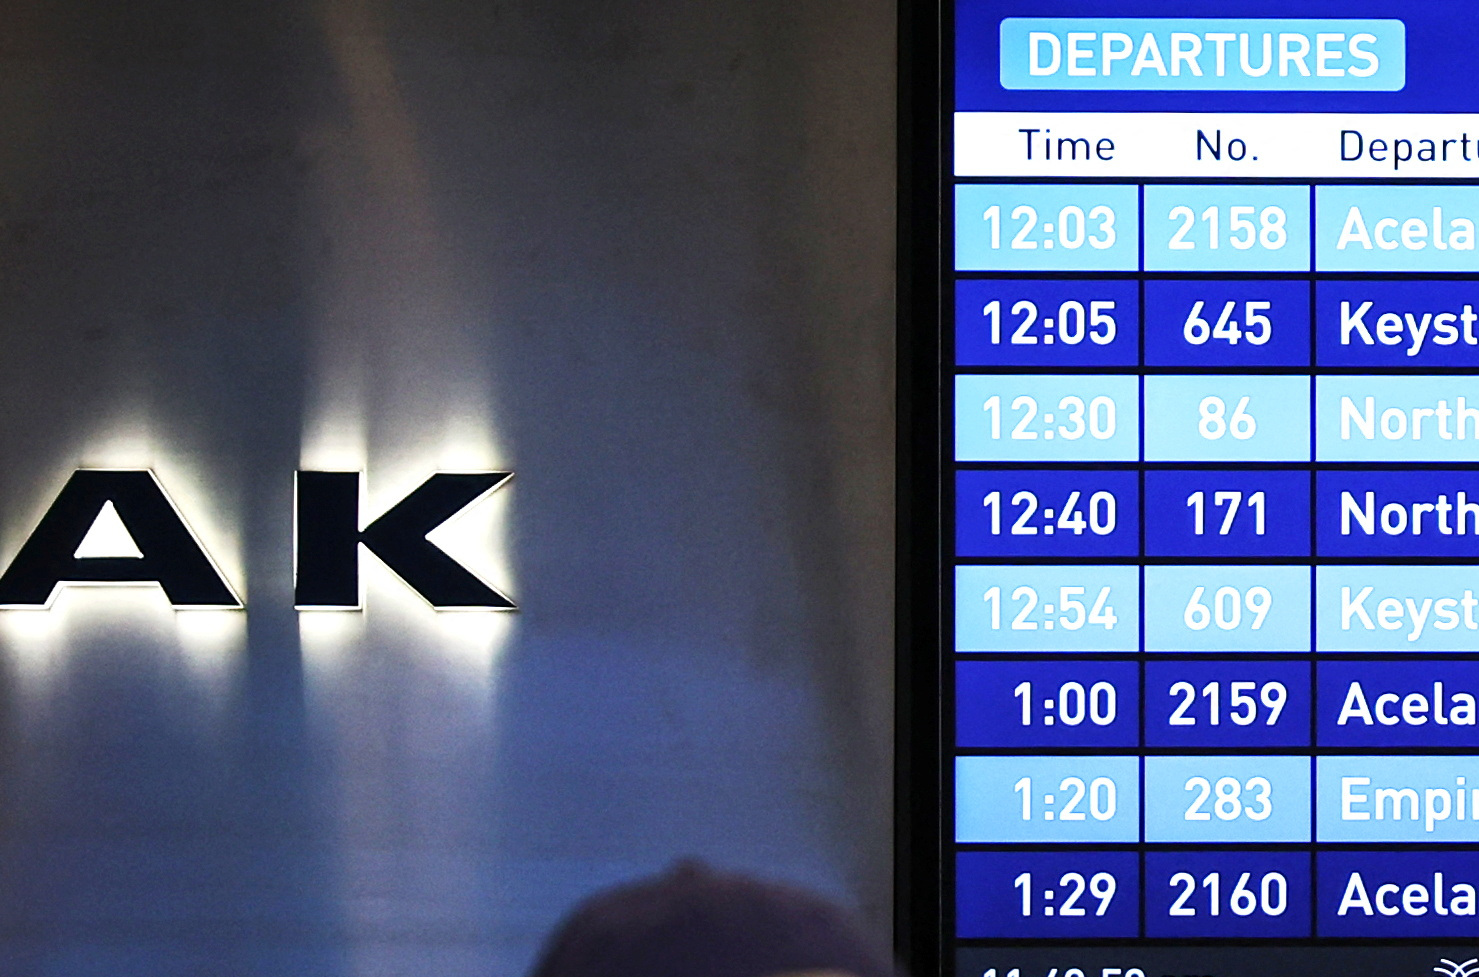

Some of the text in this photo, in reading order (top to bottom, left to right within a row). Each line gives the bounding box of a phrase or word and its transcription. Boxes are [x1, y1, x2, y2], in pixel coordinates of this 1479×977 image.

[1029, 32, 1379, 78] DEPARTURES
[1018, 128, 1115, 161] Time
[1196, 129, 1258, 162] No.
[983, 205, 1116, 250] 12:03
[1168, 205, 1287, 250] 2158
[1336, 206, 1475, 251] Acela
[983, 300, 1116, 345] 12:05
[1183, 300, 1272, 346] 645
[983, 395, 1116, 440] 12:30
[1198, 396, 1256, 440] 86
[983, 491, 1116, 536] 12:40
[1187, 491, 1265, 535] 171
[983, 586, 1118, 631] 12:54
[1184, 586, 1272, 631] 609
[1014, 681, 1116, 726] 1:00
[1169, 681, 1287, 726] 2159
[1337, 681, 1476, 726] Acela
[1014, 777, 1116, 821] 1:20
[1184, 776, 1272, 821] 283
[1014, 872, 1116, 916] 1:29
[1169, 872, 1287, 916] 2160
[1337, 872, 1476, 916] Acela
